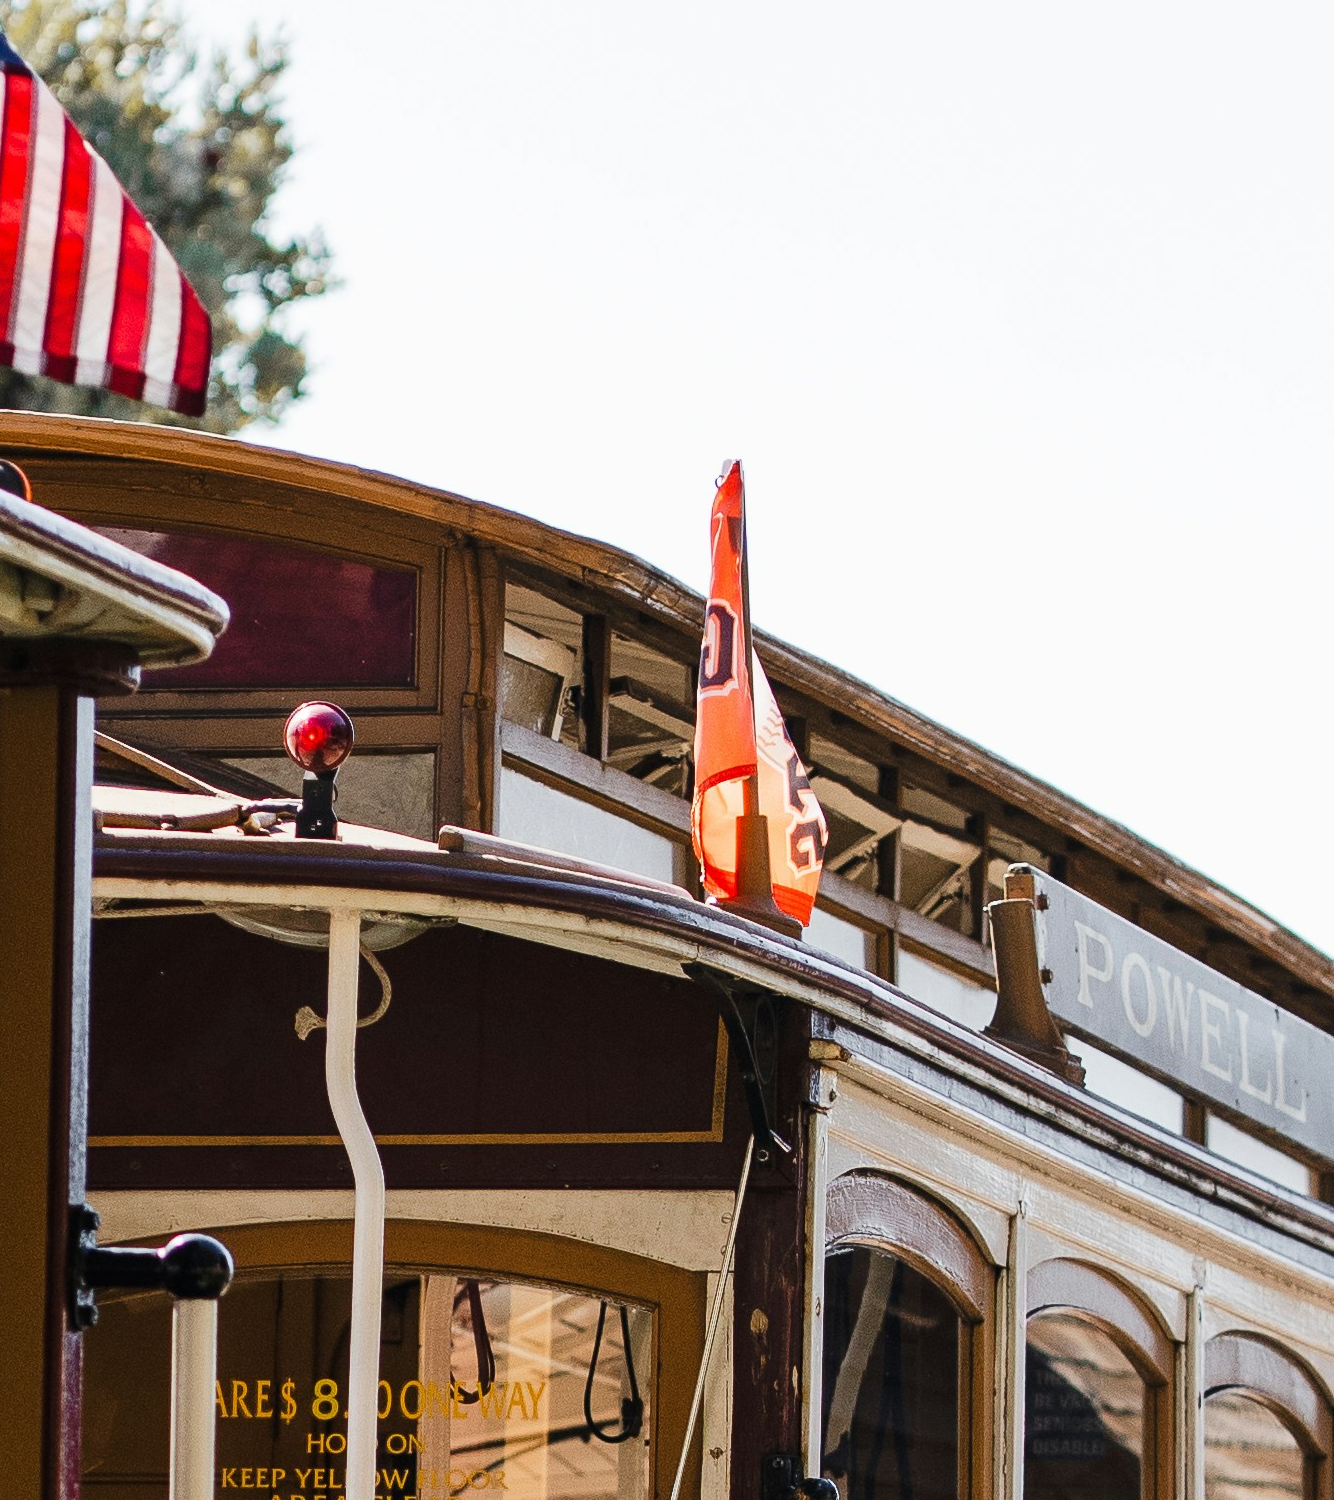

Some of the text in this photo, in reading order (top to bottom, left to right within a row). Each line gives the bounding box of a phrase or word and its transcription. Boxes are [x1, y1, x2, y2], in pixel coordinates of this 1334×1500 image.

[1072, 920, 1307, 1123] POWELL
[214, 1379, 273, 1418] ARE
[399, 1381, 467, 1420] ONE
[476, 1380, 546, 1421] WAY
[386, 1432, 426, 1455] ON
[221, 1467, 509, 1491] KEEP YELW FLOOR
